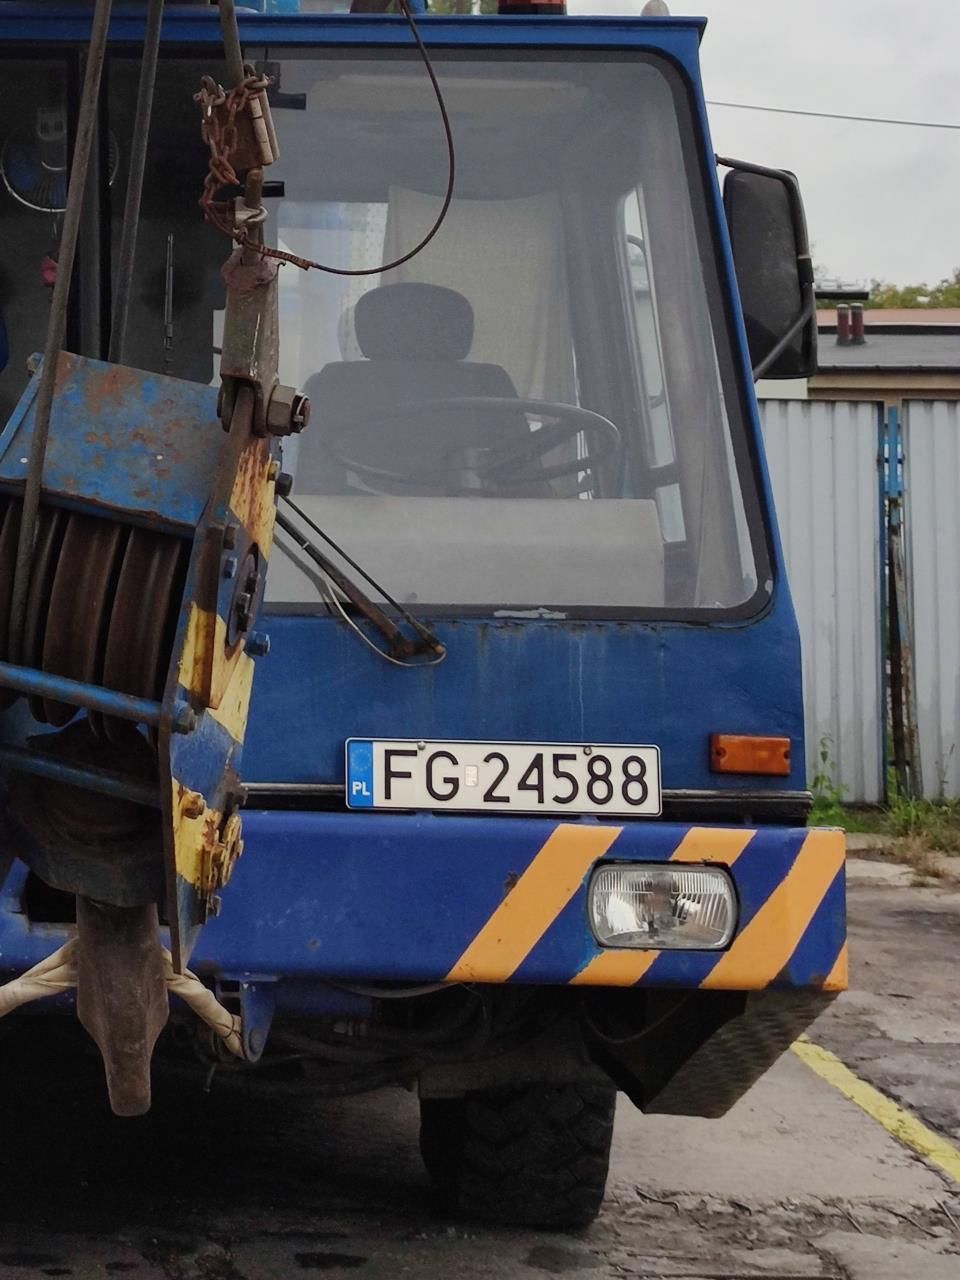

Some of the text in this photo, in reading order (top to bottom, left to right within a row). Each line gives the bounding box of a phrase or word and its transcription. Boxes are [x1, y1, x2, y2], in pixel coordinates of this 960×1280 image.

[352, 781, 370, 796] PL
[384, 748, 649, 806] FG 24588
